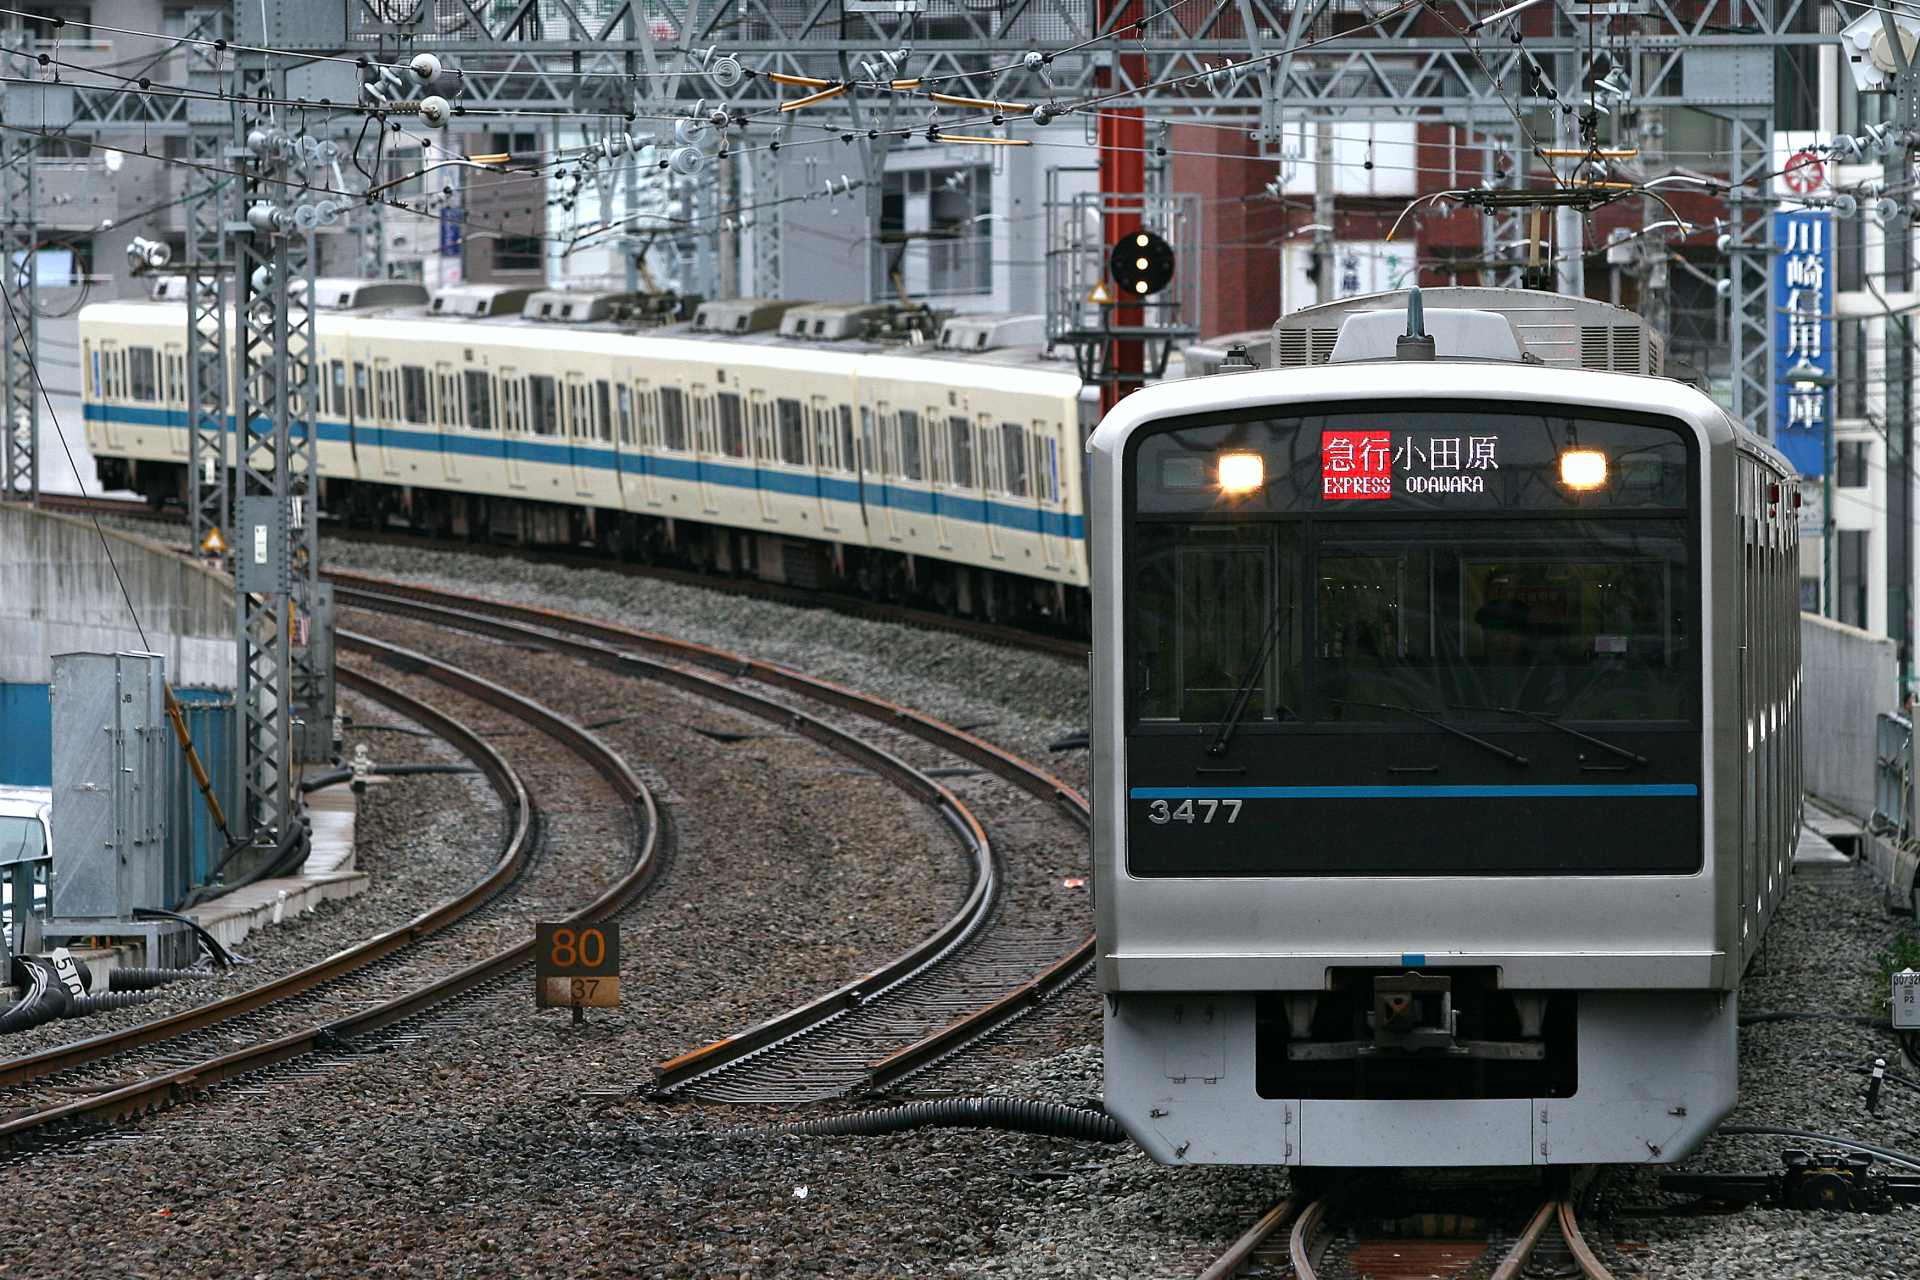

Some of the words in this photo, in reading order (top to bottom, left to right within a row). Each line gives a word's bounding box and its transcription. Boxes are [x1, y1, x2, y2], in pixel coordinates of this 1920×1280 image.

[1324, 437, 1391, 472] 急行
[1392, 435, 1499, 471] 小田原
[1324, 477, 1391, 494] EXPRESS
[1406, 476, 1484, 493] ODAWARA
[1149, 799, 1243, 824] 3477
[551, 928, 606, 967] 80
[571, 979, 600, 999] 37
[1904, 996, 1915, 1004] P2
